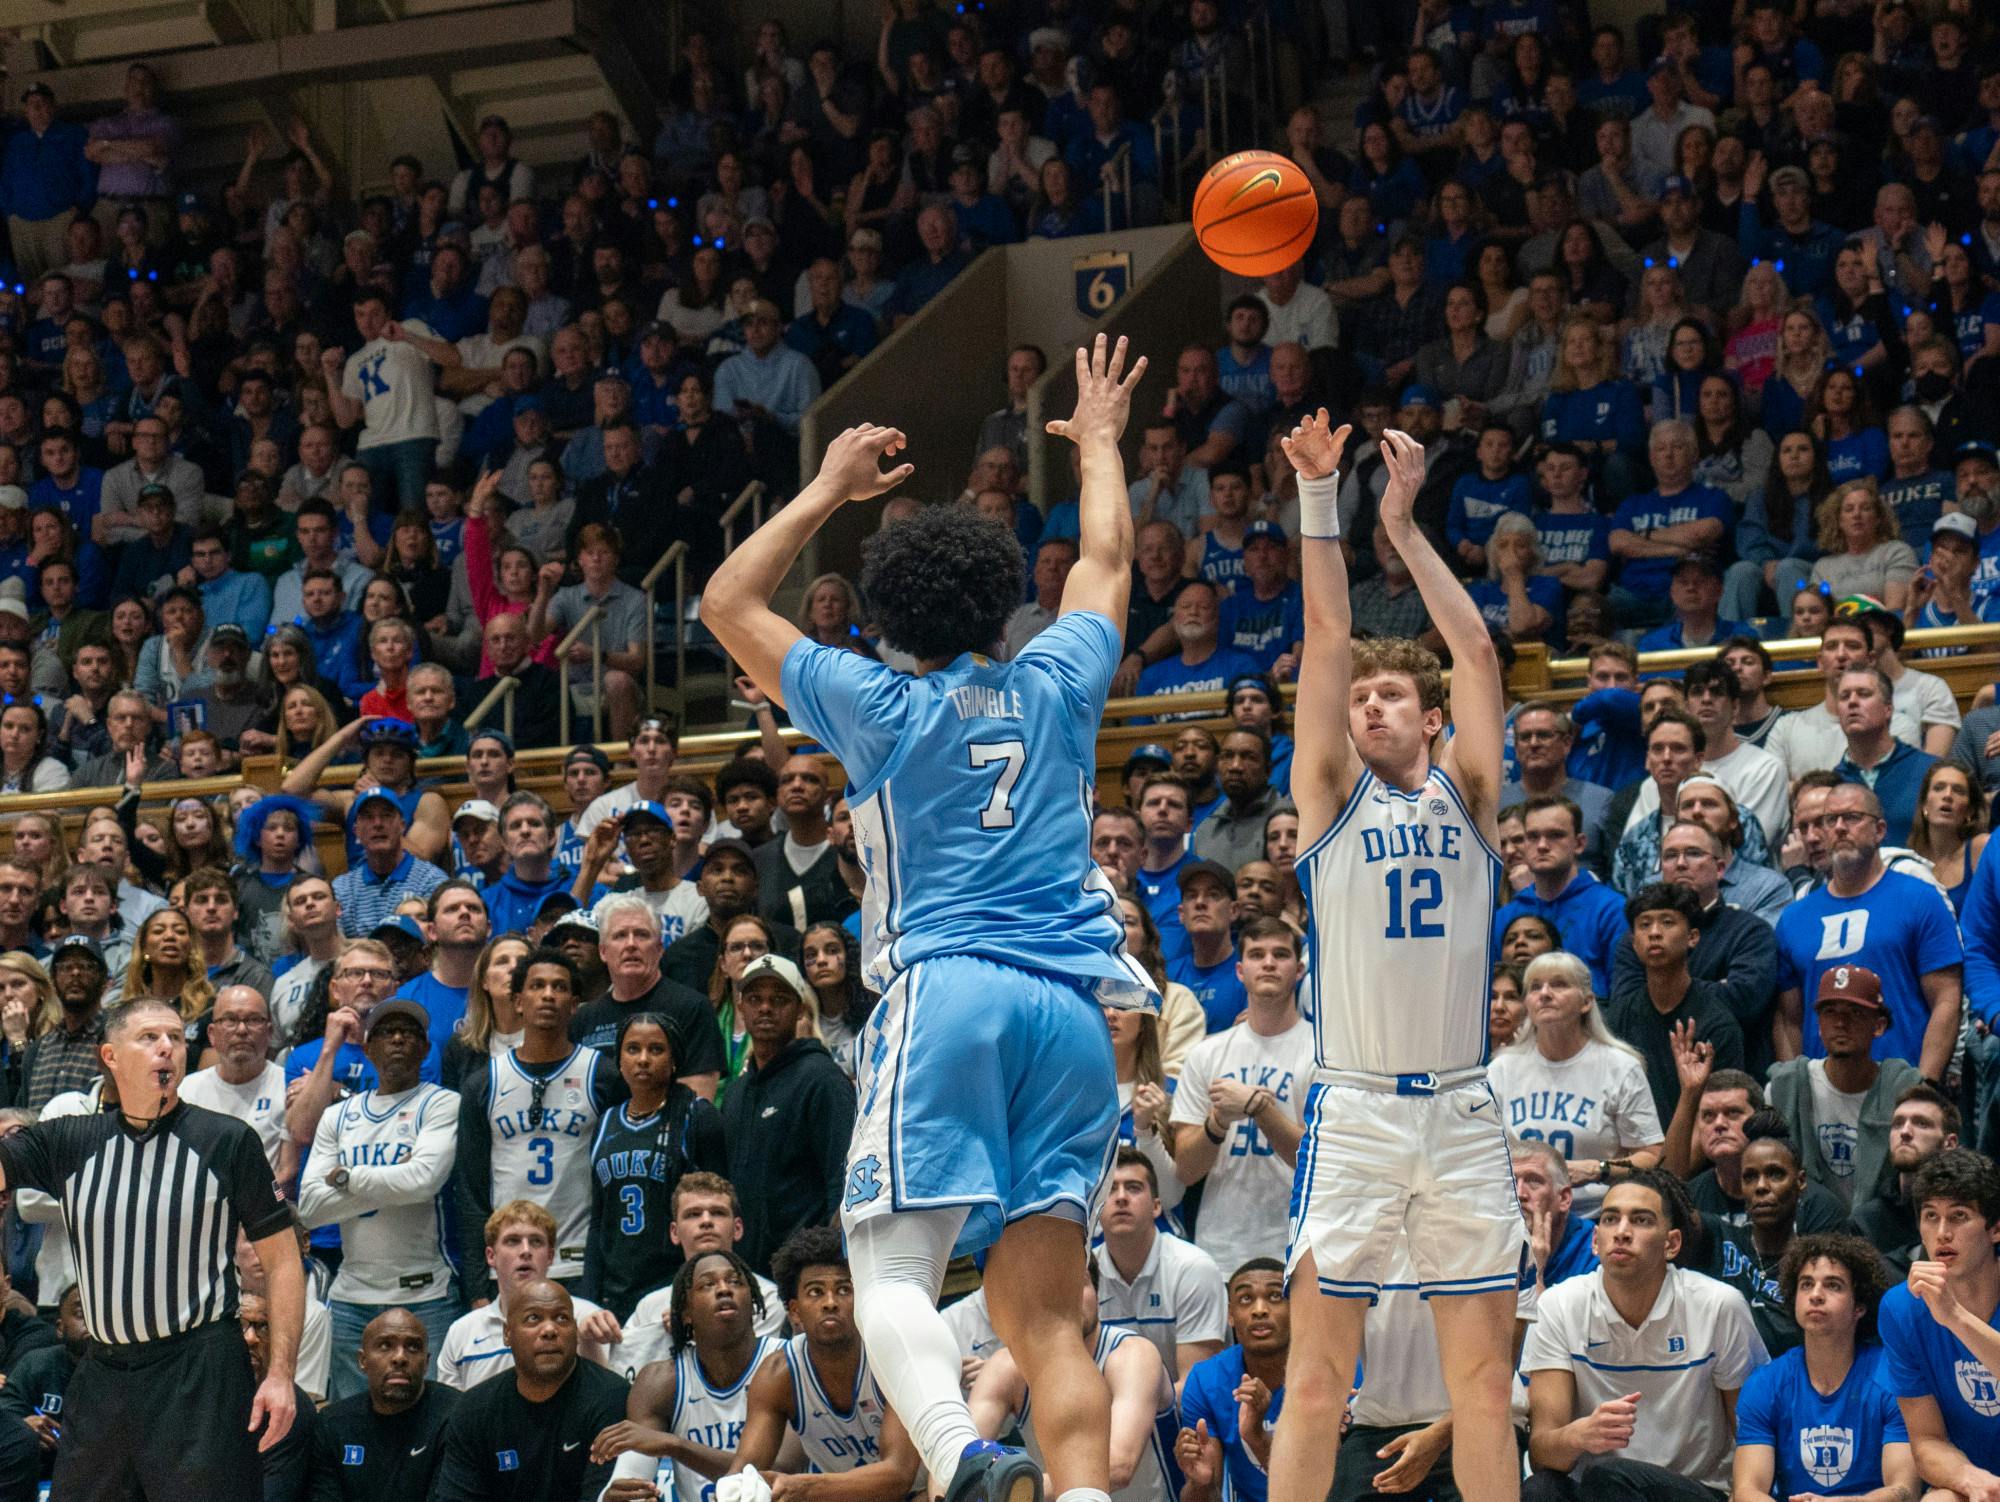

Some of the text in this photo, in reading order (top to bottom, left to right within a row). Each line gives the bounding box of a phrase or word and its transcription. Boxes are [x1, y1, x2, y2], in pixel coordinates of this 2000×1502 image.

[1088, 272, 1115, 310] 6
[359, 356, 389, 401] K
[1204, 558, 1246, 579] DUK
[946, 685, 1024, 720] TRIMBLE
[968, 740, 1027, 829] 7
[1361, 823, 1461, 863] DUKE
[1385, 868, 1445, 938] 12
[1815, 909, 1869, 961] D
[495, 1108, 588, 1139] DUKE
[1510, 1091, 1595, 1127] DUKE
[527, 1137, 555, 1185] 3
[596, 1150, 669, 1187] DUKE
[620, 1184, 645, 1235] 3
[687, 1421, 746, 1449] DUK
[821, 1435, 880, 1457] DUK
